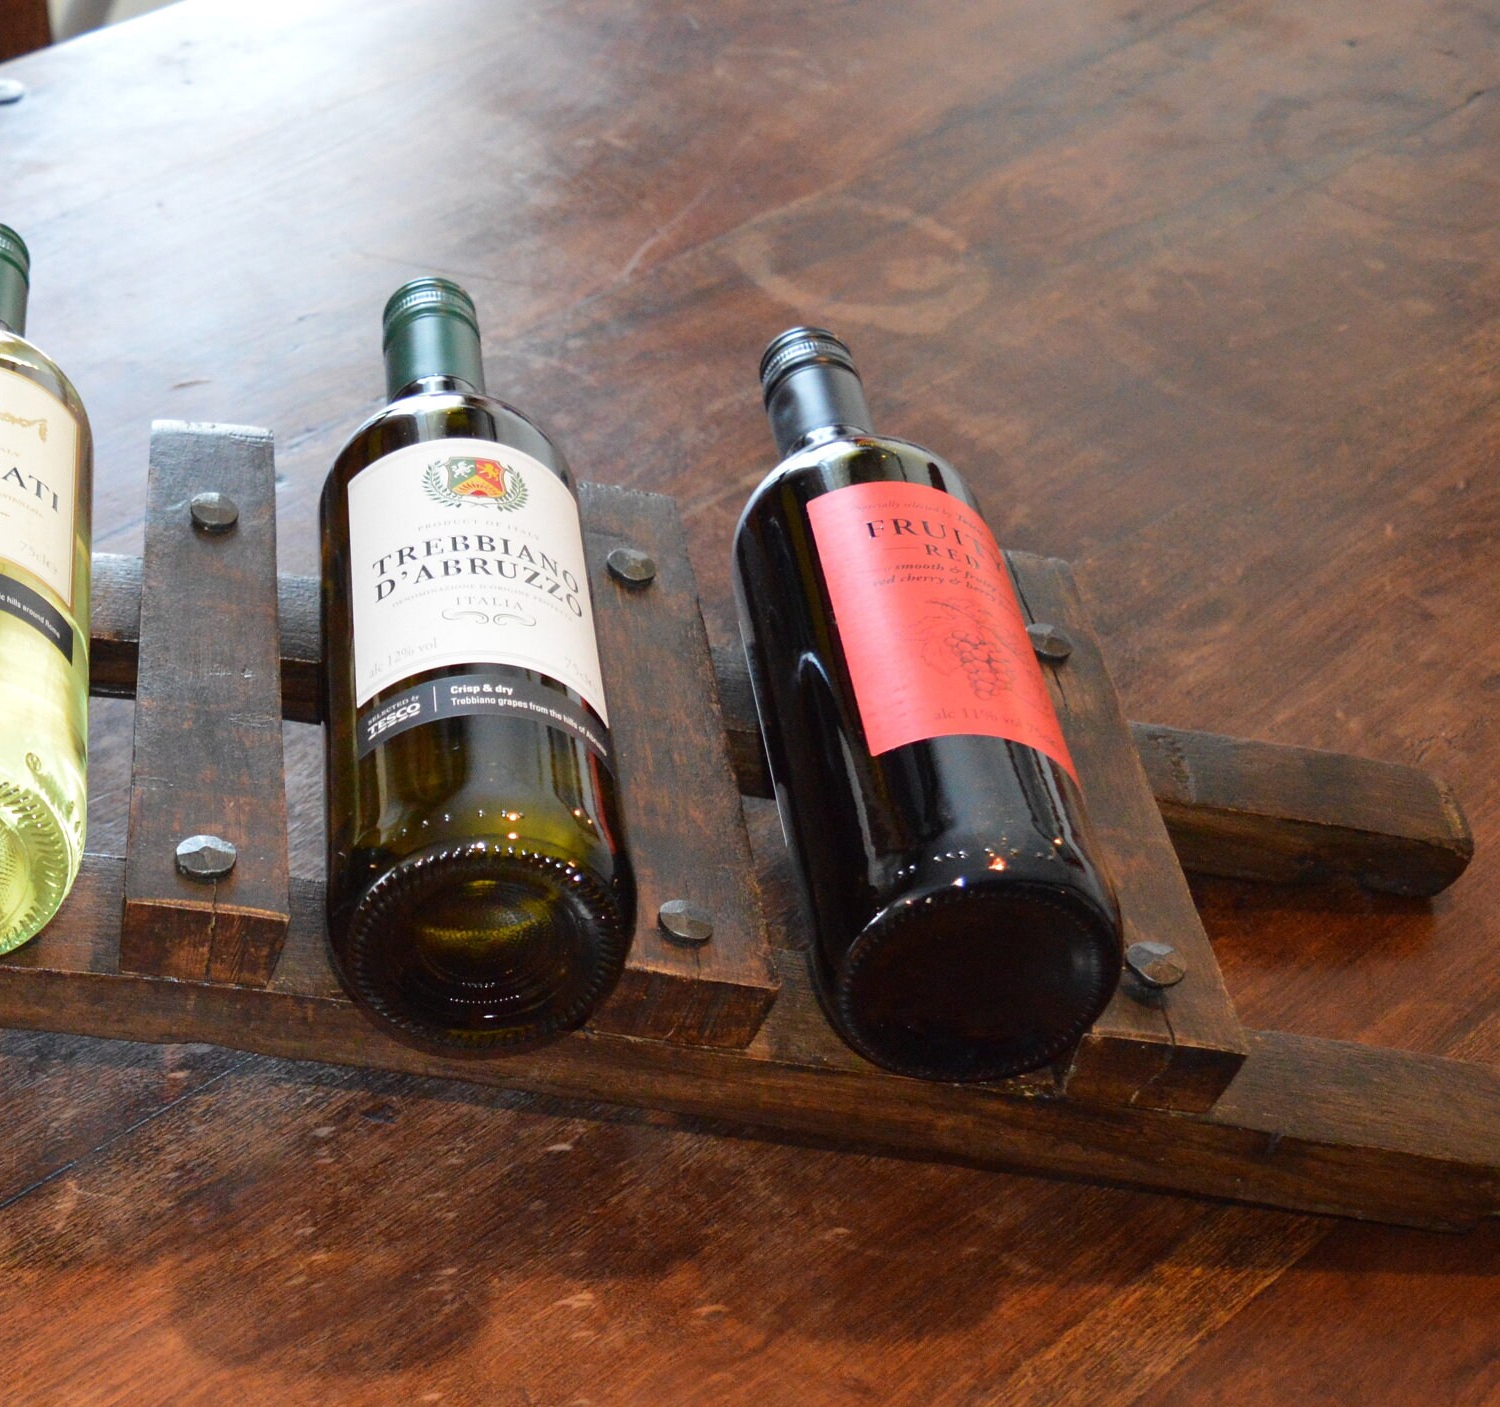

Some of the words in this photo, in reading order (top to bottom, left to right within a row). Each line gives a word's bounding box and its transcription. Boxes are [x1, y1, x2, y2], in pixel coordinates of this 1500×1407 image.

[372, 534, 579, 594] TREBBIANO
[895, 563, 945, 571] smooth
[925, 543, 980, 570] RED
[375, 557, 583, 618] D'ABRUZZO
[901, 573, 945, 585] cherry
[7, 595, 21, 609] hills
[22, 603, 45, 624] around
[456, 596, 523, 612] ITALIA
[451, 684, 480, 696] Crisp
[482, 684, 493, 693] &
[495, 685, 513, 696] dry
[368, 698, 409, 725] SELECTED
[368, 702, 421, 740] TESCO
[451, 697, 496, 706] Trebbiano
[498, 699, 528, 709] grapes
[529, 701, 548, 715] from
[549, 708, 562, 720] the
[563, 714, 578, 730] hills
